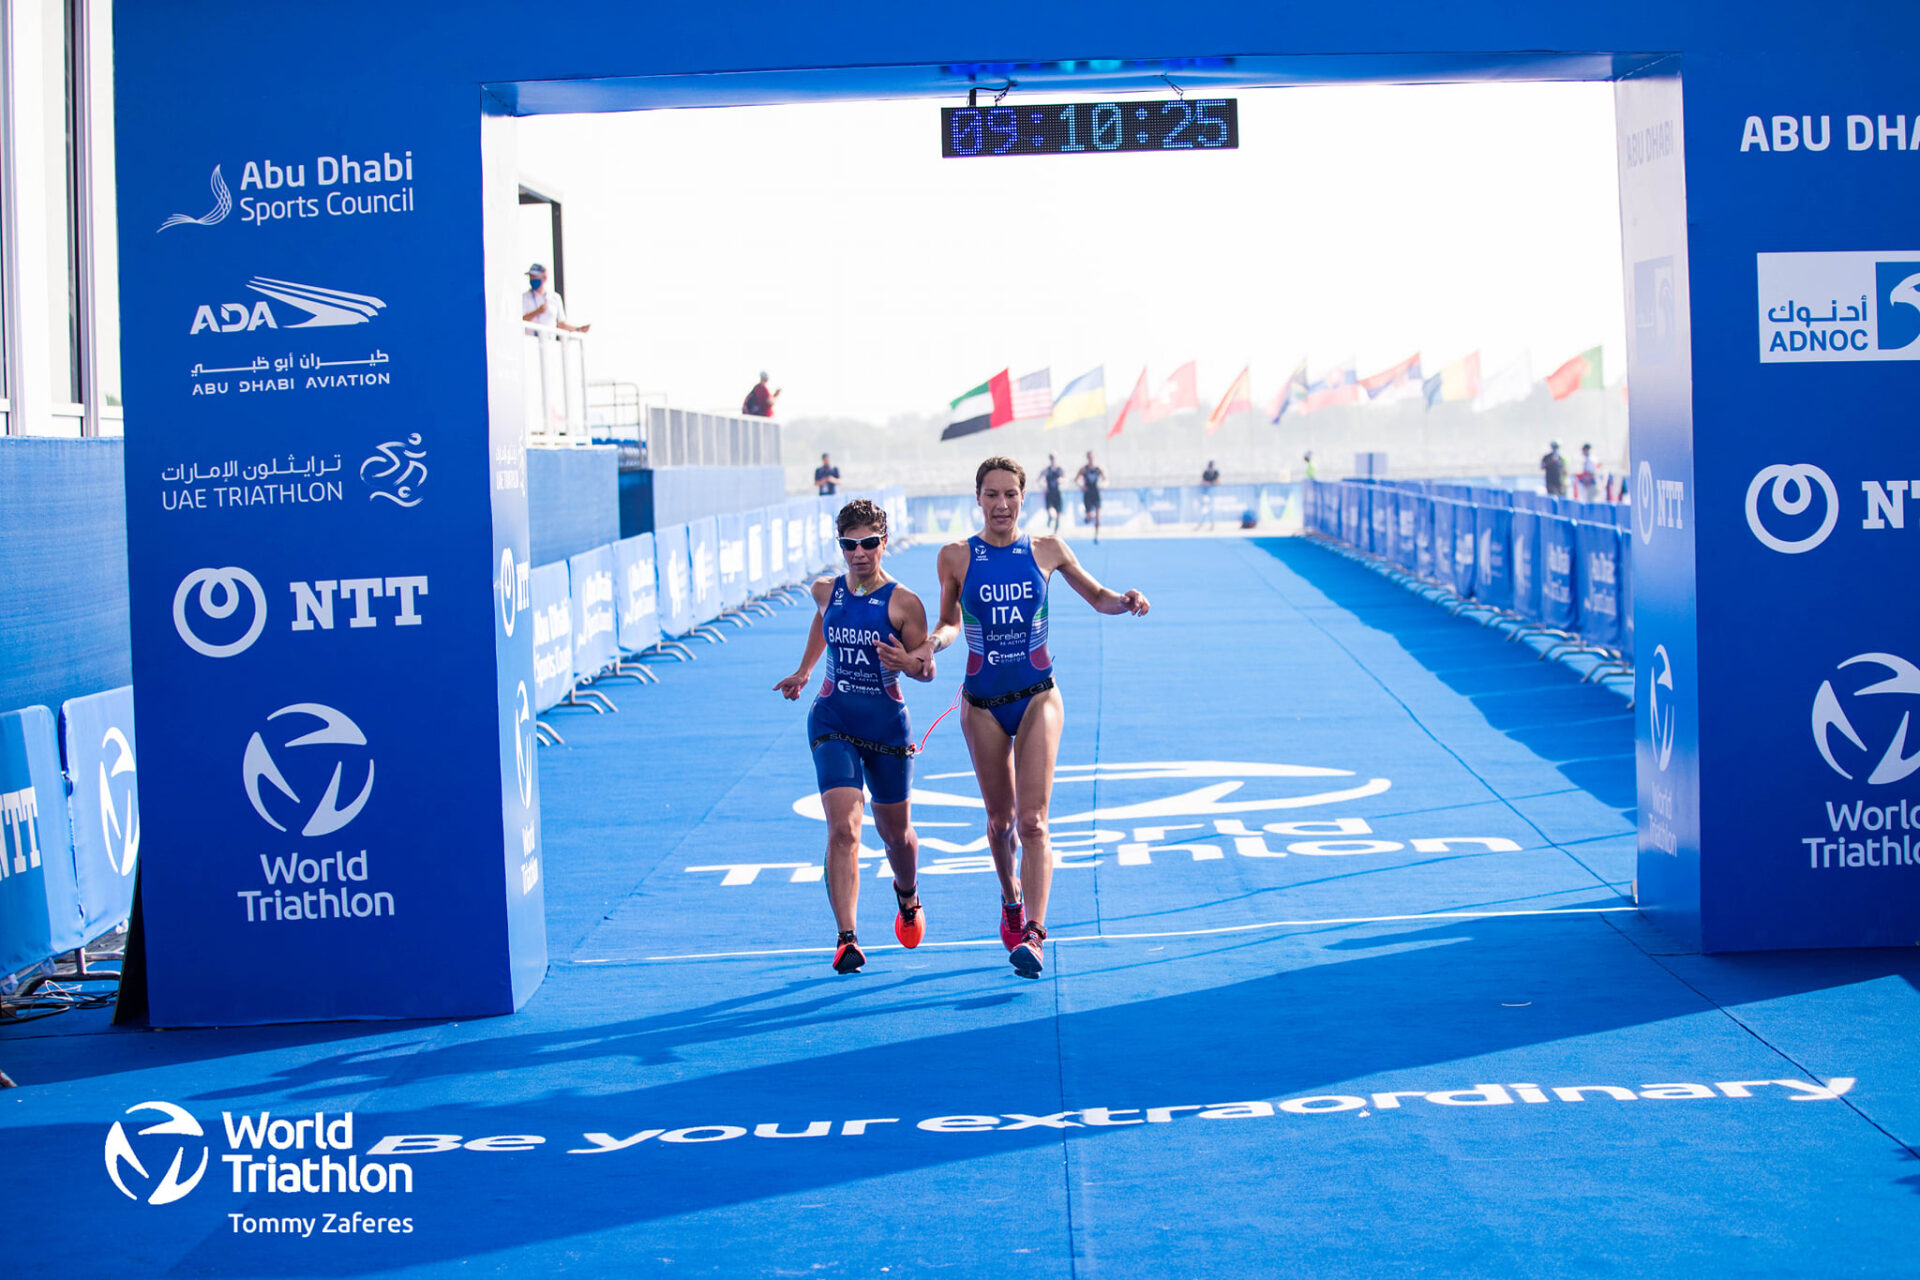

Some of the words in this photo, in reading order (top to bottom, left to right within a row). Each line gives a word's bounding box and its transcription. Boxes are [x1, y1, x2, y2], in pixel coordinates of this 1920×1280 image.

[951, 99, 1228, 156] 09:10:25
[1739, 115, 1831, 152] ABU
[240, 159, 305, 191] Abu
[317, 151, 413, 186] Dhabi
[240, 195, 319, 226] Sports
[326, 187, 414, 216] Council
[189, 301, 279, 335] ADA
[1768, 294, 1868, 329] أدنوك
[1769, 328, 1869, 352] ADNOC
[274, 352, 294, 372] أبو
[192, 382, 229, 396] ABU
[239, 378, 295, 393] DHABI
[305, 372, 390, 389] AVIATION
[162, 488, 207, 510] UAE
[213, 481, 343, 507] TRIATHLON
[1656, 479, 1684, 530] NTT
[290, 575, 429, 632] NTT
[979, 580, 1033, 603] GUIDE
[992, 605, 1025, 625] ITA
[828, 626, 880, 646] BARBARO
[986, 628, 1027, 641] dorelan
[839, 646, 871, 665] ITA
[259, 849, 368, 886] World
[237, 887, 395, 922] Triathlon
[366, 1134, 547, 1155] Be
[567, 1117, 900, 1154] your
[916, 1077, 1856, 1132] extraordinary
